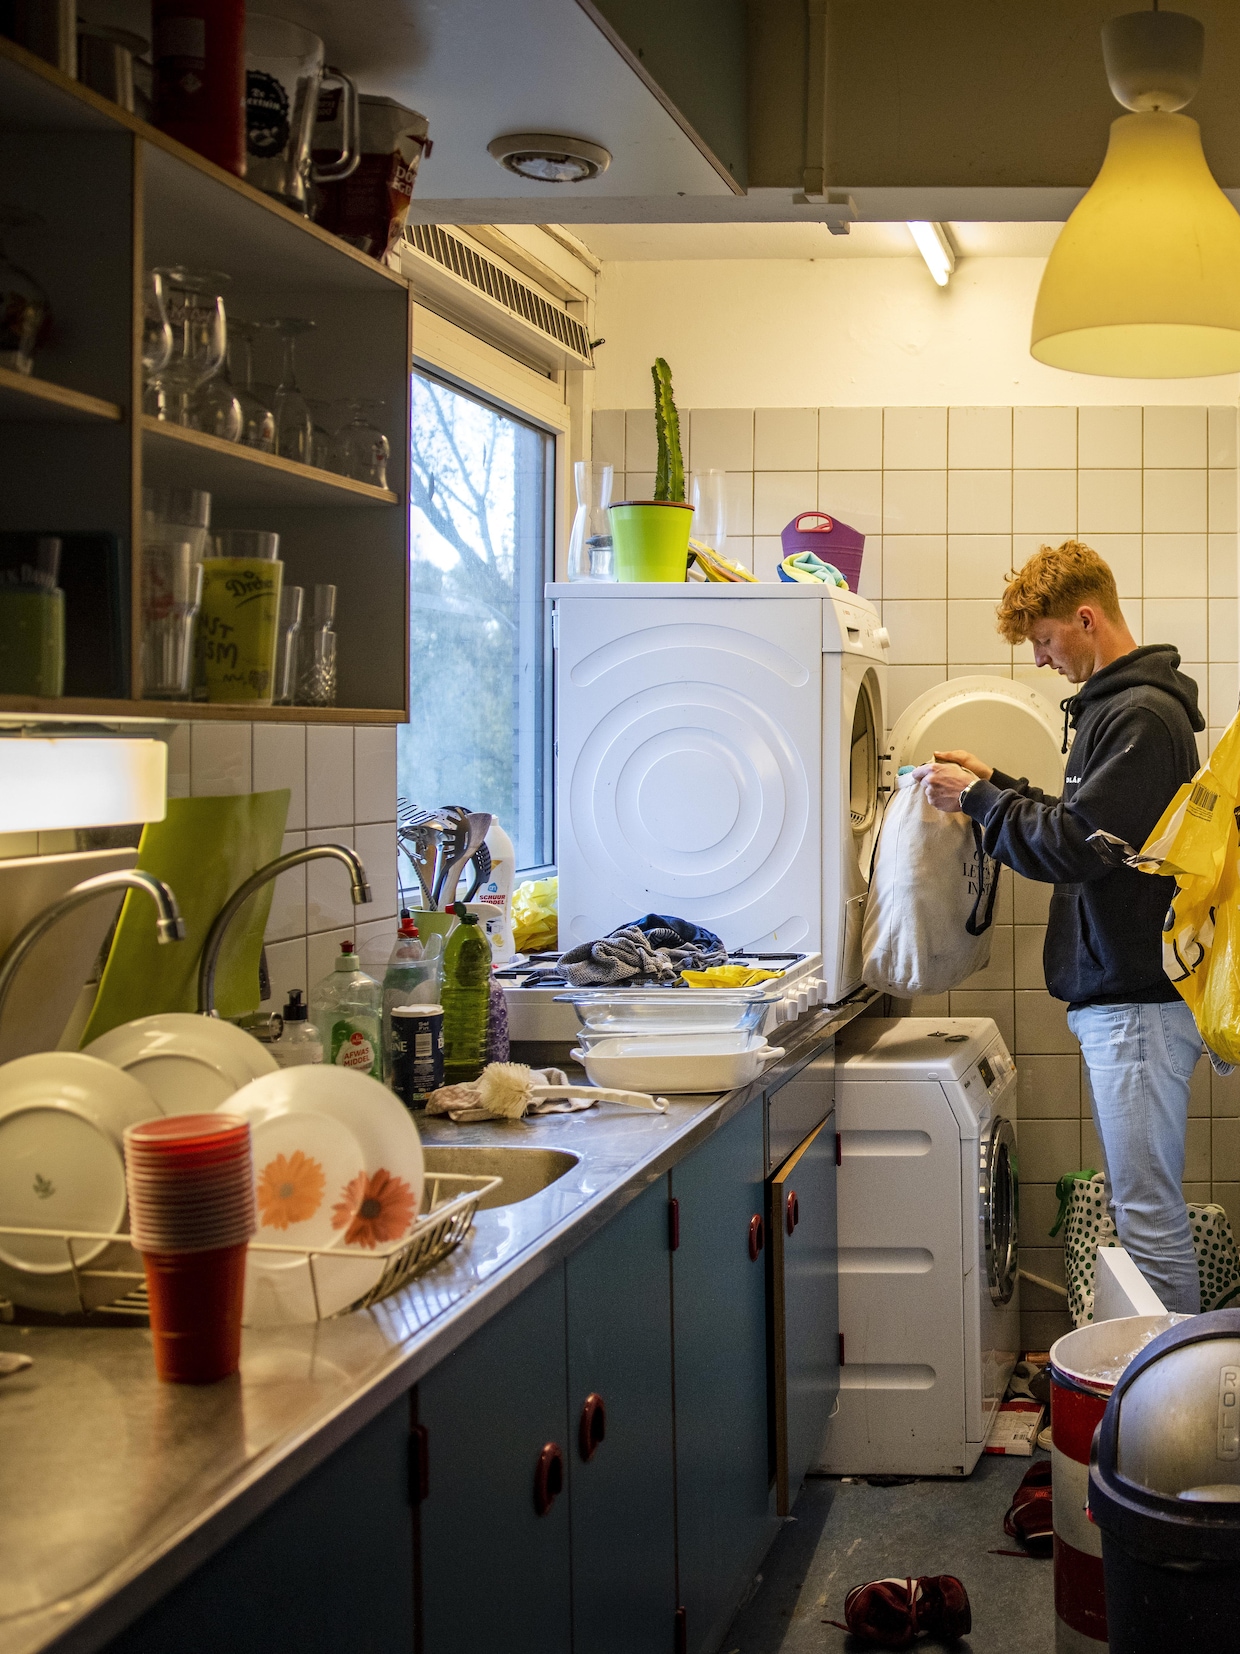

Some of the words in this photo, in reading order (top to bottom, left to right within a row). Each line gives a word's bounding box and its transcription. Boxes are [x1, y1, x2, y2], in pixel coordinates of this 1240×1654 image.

[344, 1047, 369, 1060] AFWAS
[343, 1055, 370, 1067] MIDDEL
[1222, 1372, 1237, 1452] ROLL
